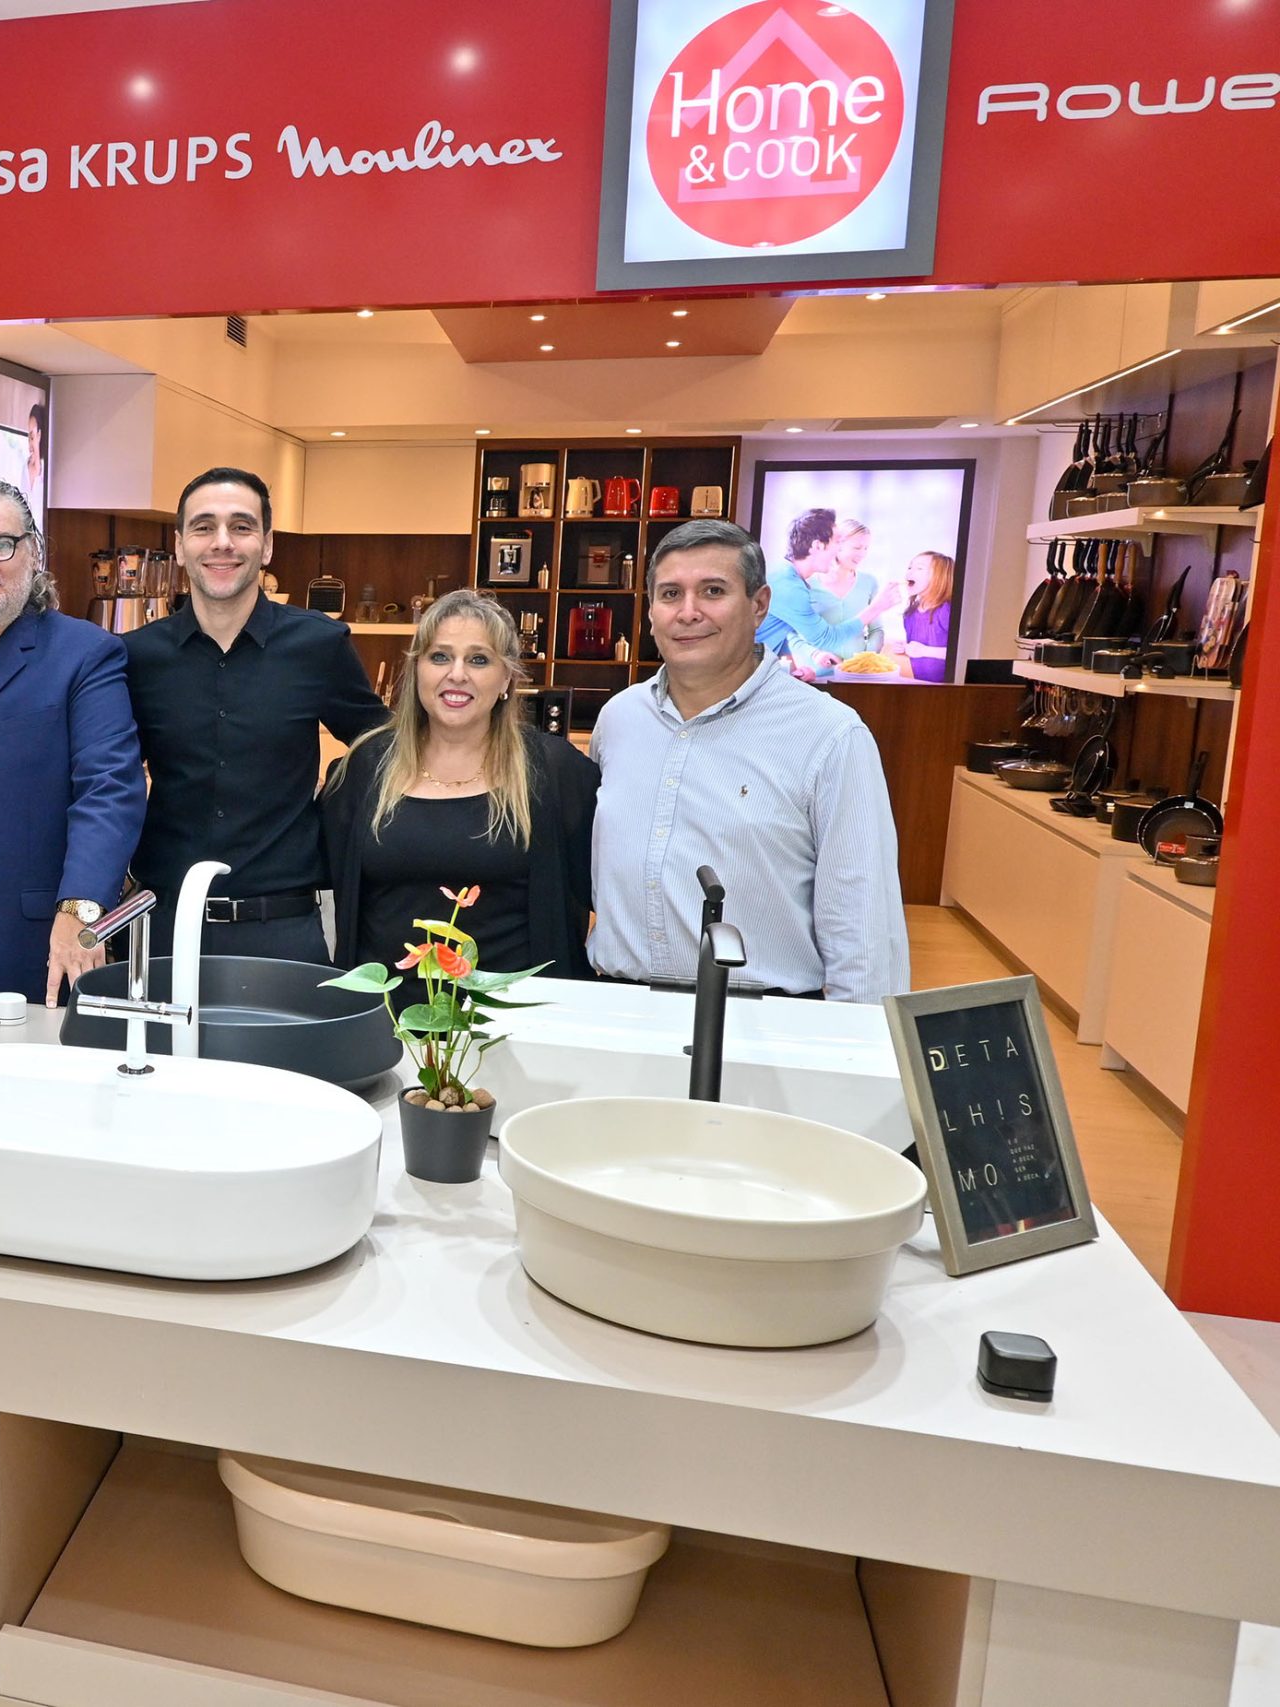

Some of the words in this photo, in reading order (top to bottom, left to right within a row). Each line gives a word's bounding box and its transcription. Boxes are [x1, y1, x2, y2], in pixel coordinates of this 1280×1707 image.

[669, 69, 885, 137] Home
[69, 132, 253, 189] KRUPS
[277, 120, 564, 179] Moulinex
[929, 1036, 1019, 1072] DETA
[958, 1163, 998, 1192] MO
